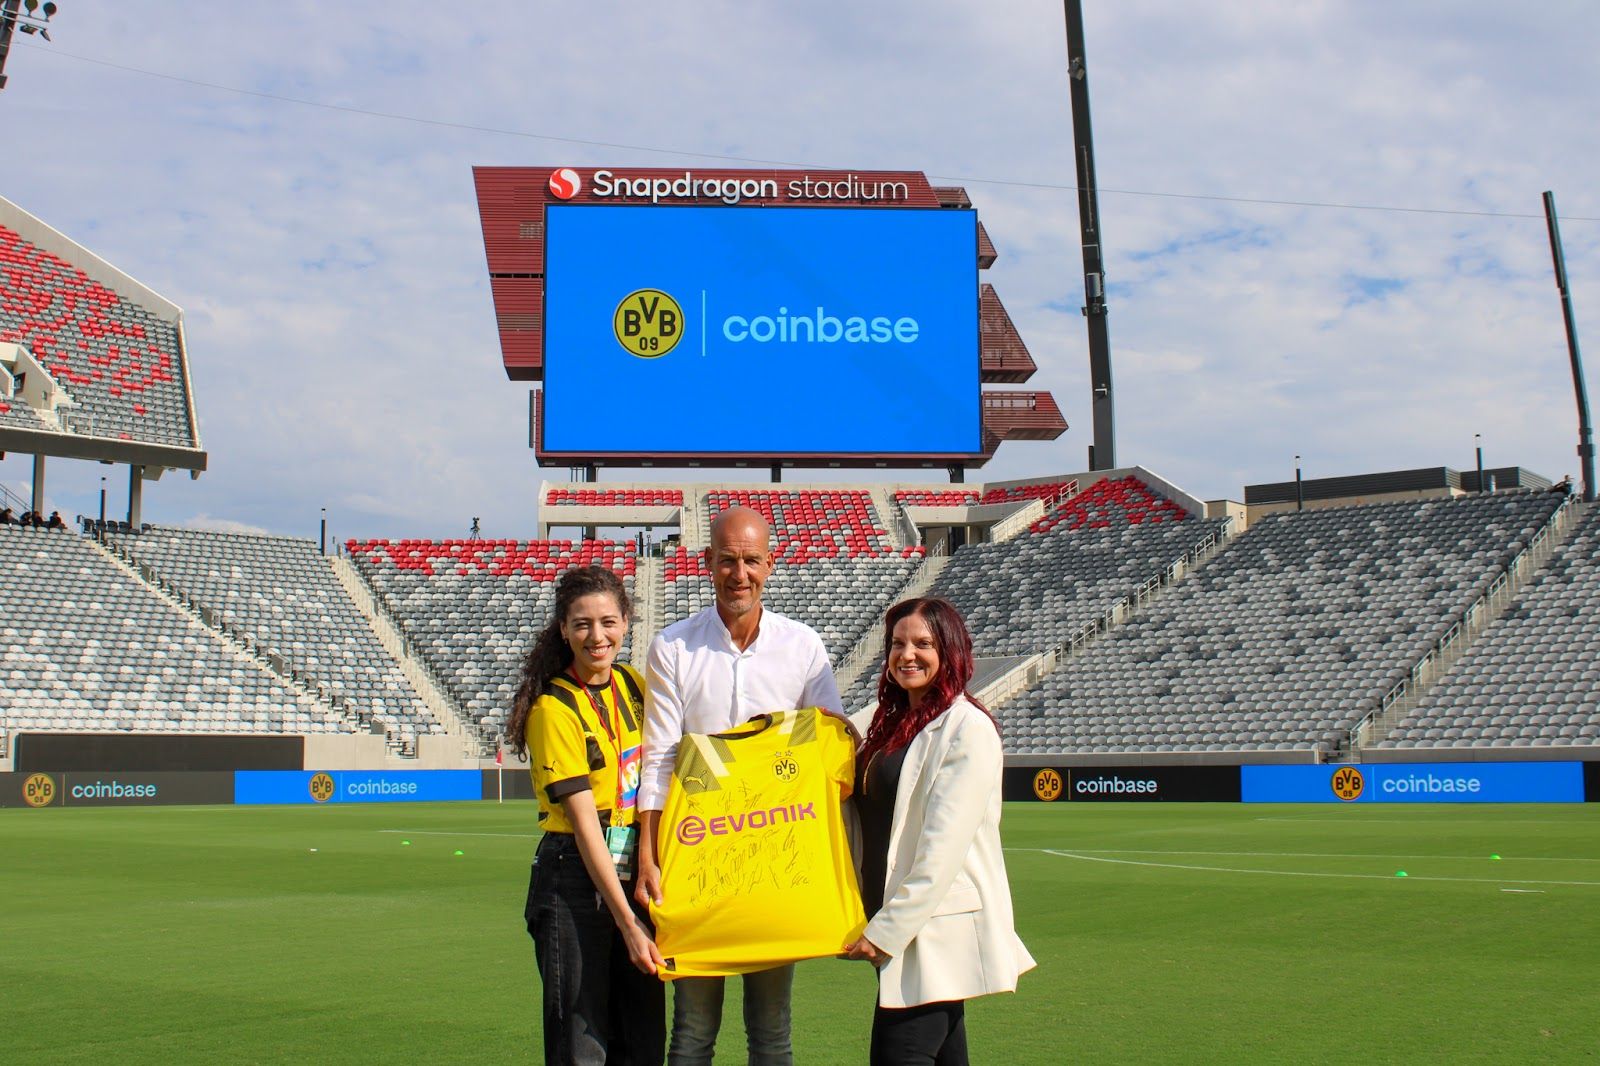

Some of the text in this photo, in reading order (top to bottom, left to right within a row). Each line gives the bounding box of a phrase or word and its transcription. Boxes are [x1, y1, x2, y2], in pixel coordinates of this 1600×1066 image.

[592, 170, 908, 204] Snapdragon stadium
[624, 296, 676, 337] BVB
[722, 306, 920, 343] coinbase
[639, 337, 659, 351] 09
[775, 760, 797, 775] BVB
[27, 777, 52, 797] BVB
[71, 781, 156, 798] coinbase
[312, 775, 332, 793] BVB
[347, 779, 417, 795] coinbase
[1038, 772, 1059, 791] BVB
[1076, 776, 1158, 793] coinbase
[1335, 770, 1361, 790] BVB
[1382, 773, 1481, 793] coinbase
